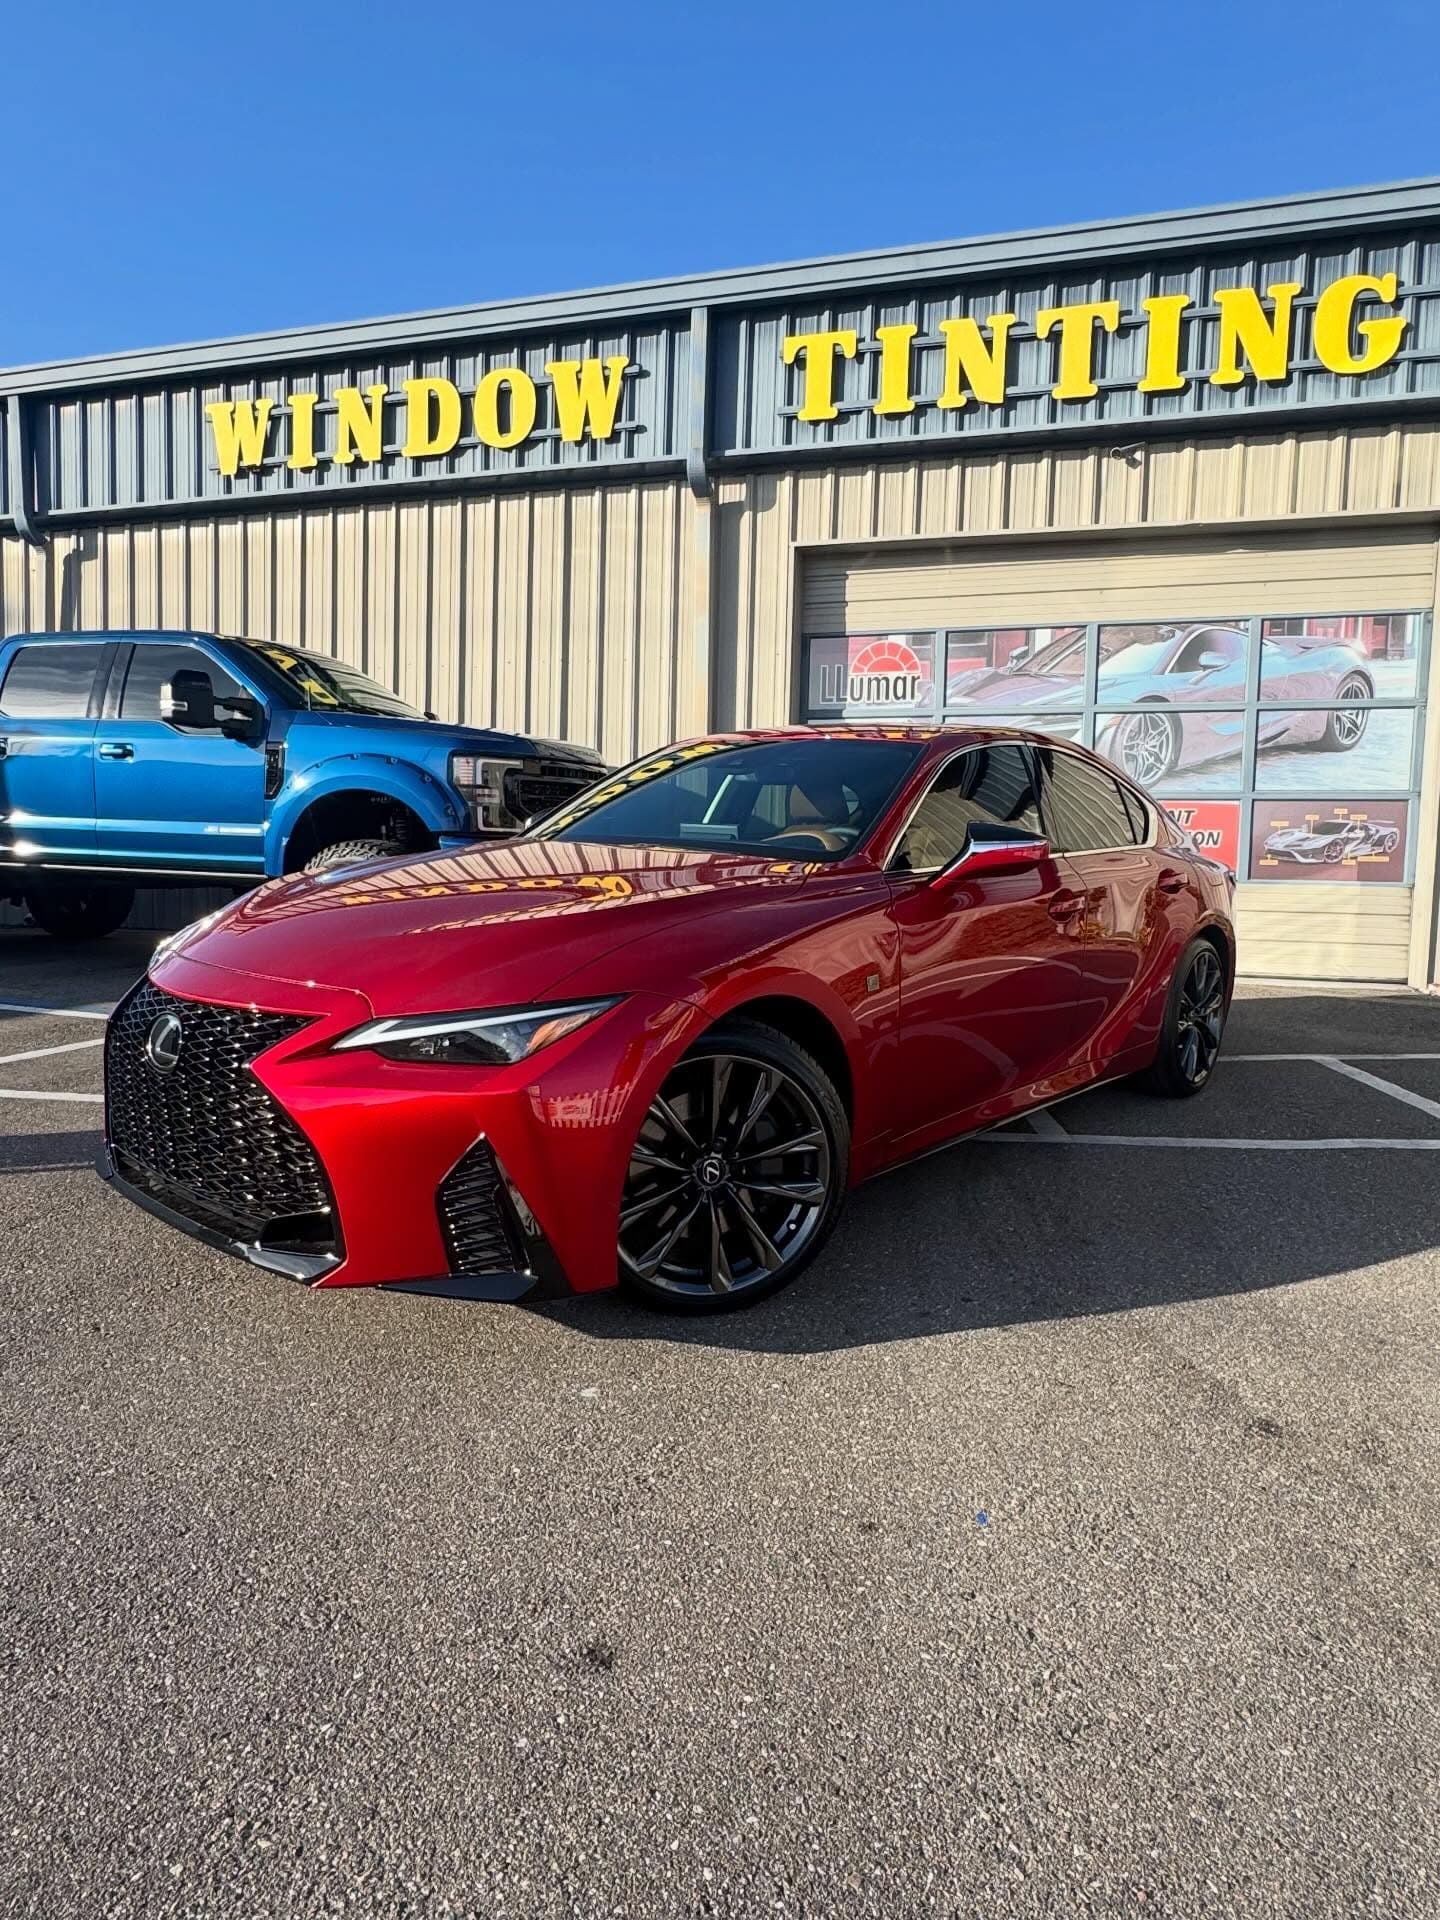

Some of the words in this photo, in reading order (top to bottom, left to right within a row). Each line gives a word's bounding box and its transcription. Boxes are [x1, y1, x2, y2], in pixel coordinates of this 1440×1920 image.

[206, 356, 629, 475] WINDOW
[784, 273, 1407, 421] TINTING
[1189, 831, 1221, 846] ON
